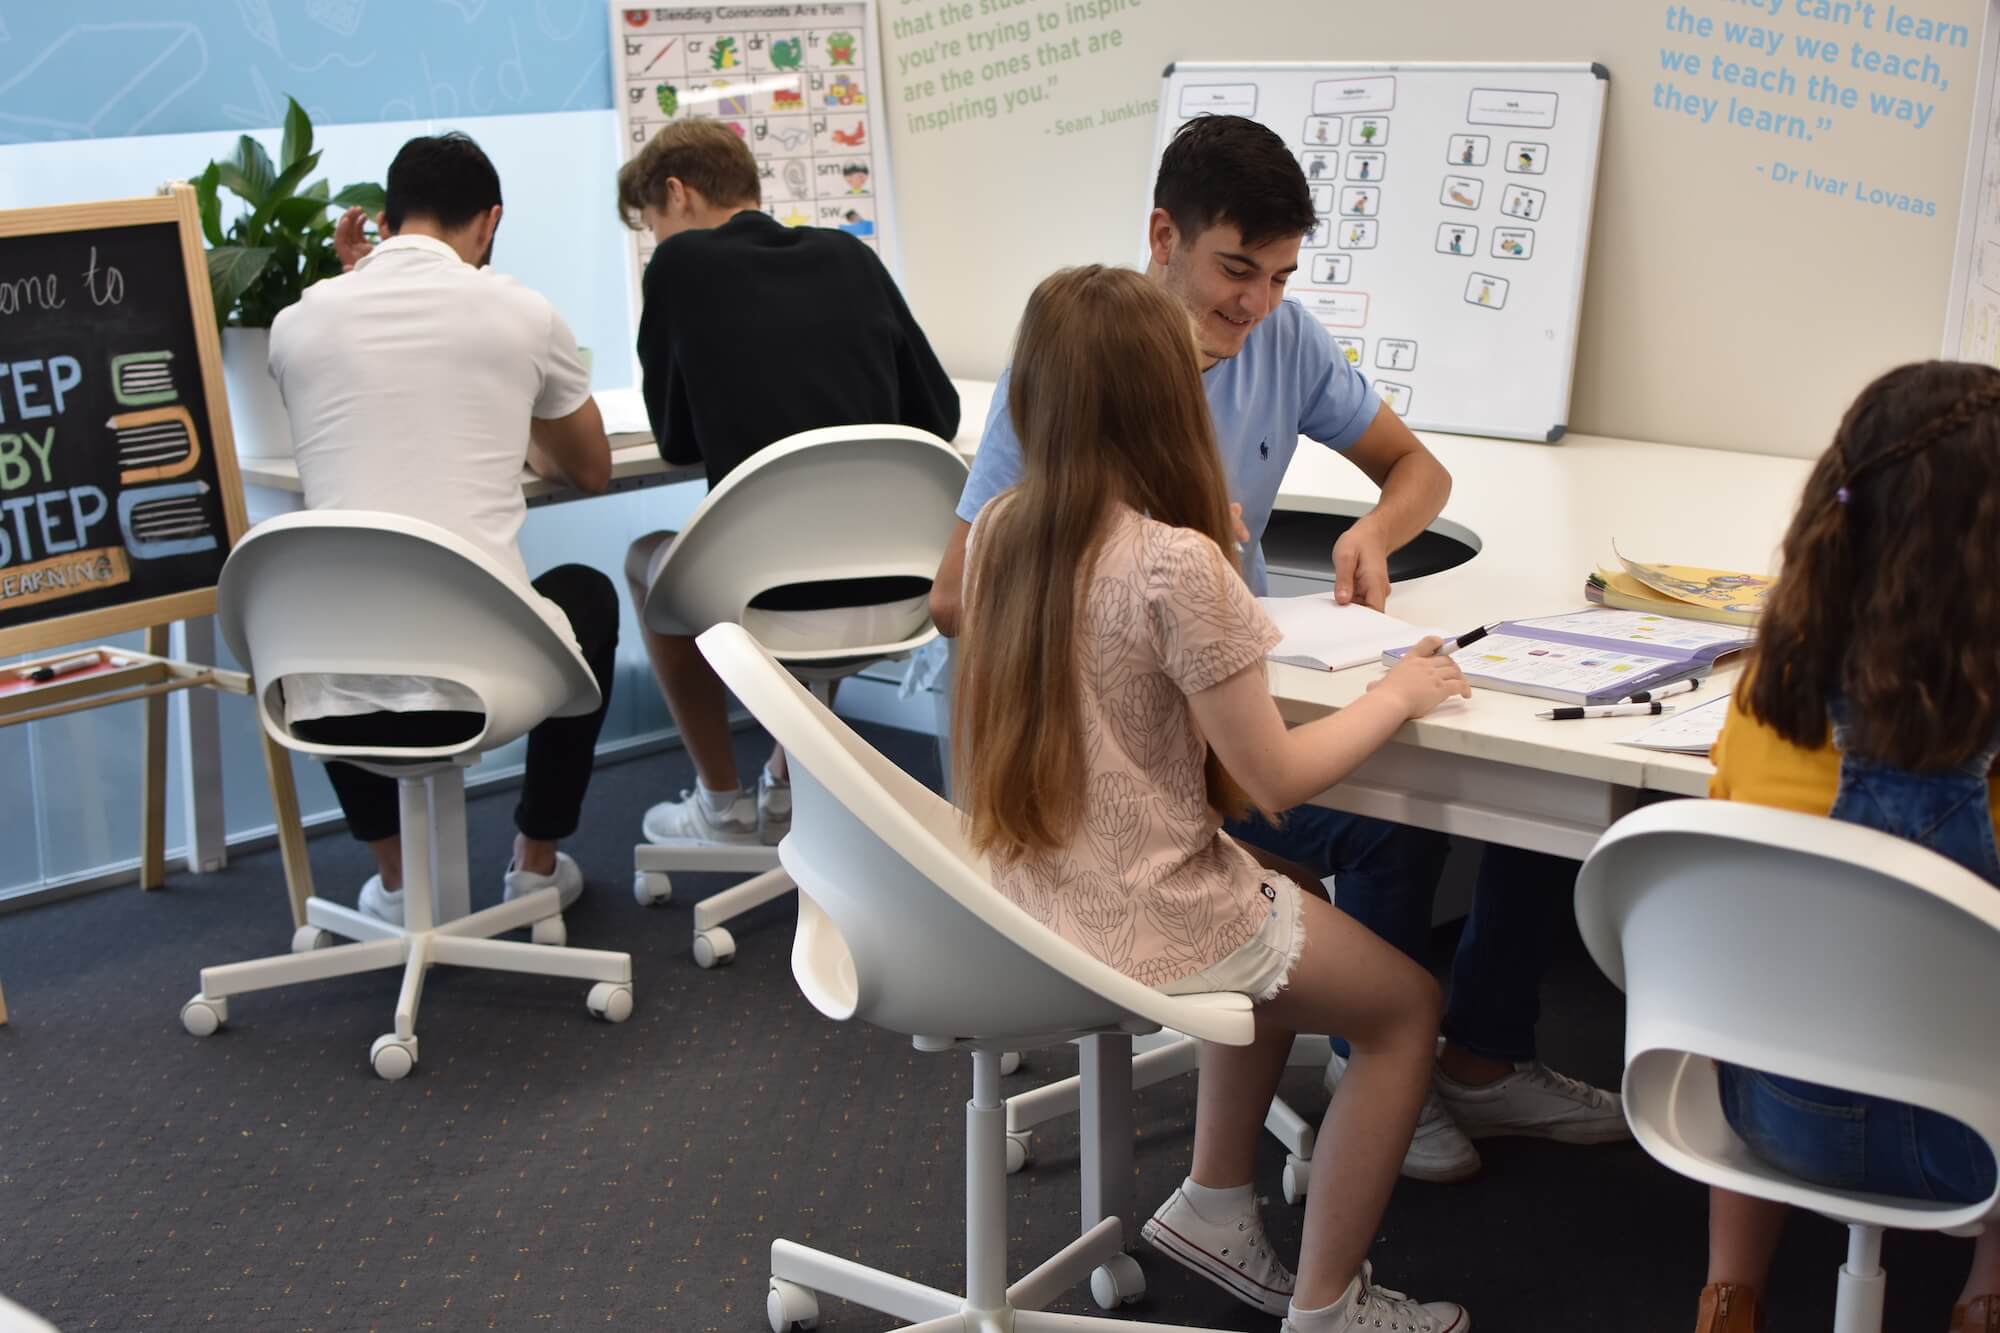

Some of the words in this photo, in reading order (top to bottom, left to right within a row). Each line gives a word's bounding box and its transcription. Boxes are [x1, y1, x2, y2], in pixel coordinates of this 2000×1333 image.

[794, 4, 819, 16] Are
[893, 11, 934, 40] that
[940, 4, 973, 28] the
[1885, 6, 1969, 48] learn
[625, 36, 643, 56] br
[748, 33, 764, 50] dr
[807, 31, 820, 48] fr
[898, 40, 961, 76] you're
[967, 20, 1031, 53] trying
[1036, 11, 1060, 33] to
[1665, 6, 1713, 37] the
[1724, 21, 1784, 56] way
[1795, 35, 1840, 63] we
[1850, 42, 1949, 92] teach,
[810, 73, 824, 91] bl
[903, 79, 935, 103] are
[940, 68, 975, 94] the
[981, 53, 1031, 82] ones
[1036, 38, 1081, 67] that
[1088, 29, 1123, 54] are
[629, 86, 646, 103] gr
[1653, 82, 1718, 124] they
[1660, 48, 1701, 75] we
[1711, 55, 1796, 96] teach
[1807, 75, 1859, 109] the
[1870, 91, 1934, 129] way
[814, 116, 828, 137] pl
[906, 95, 998, 135] inspiring
[1055, 115, 1094, 136] Sean
[1098, 99, 1160, 126] Junkins
[817, 163, 841, 177] sm
[1771, 161, 1800, 184] Dr
[1804, 169, 1848, 196] Ivar
[1855, 181, 1936, 218] Lovaas
[820, 206, 842, 218] sw
[81, 246, 124, 306] to
[0, 427, 56, 491] BY
[0, 555, 113, 600] EARNING
